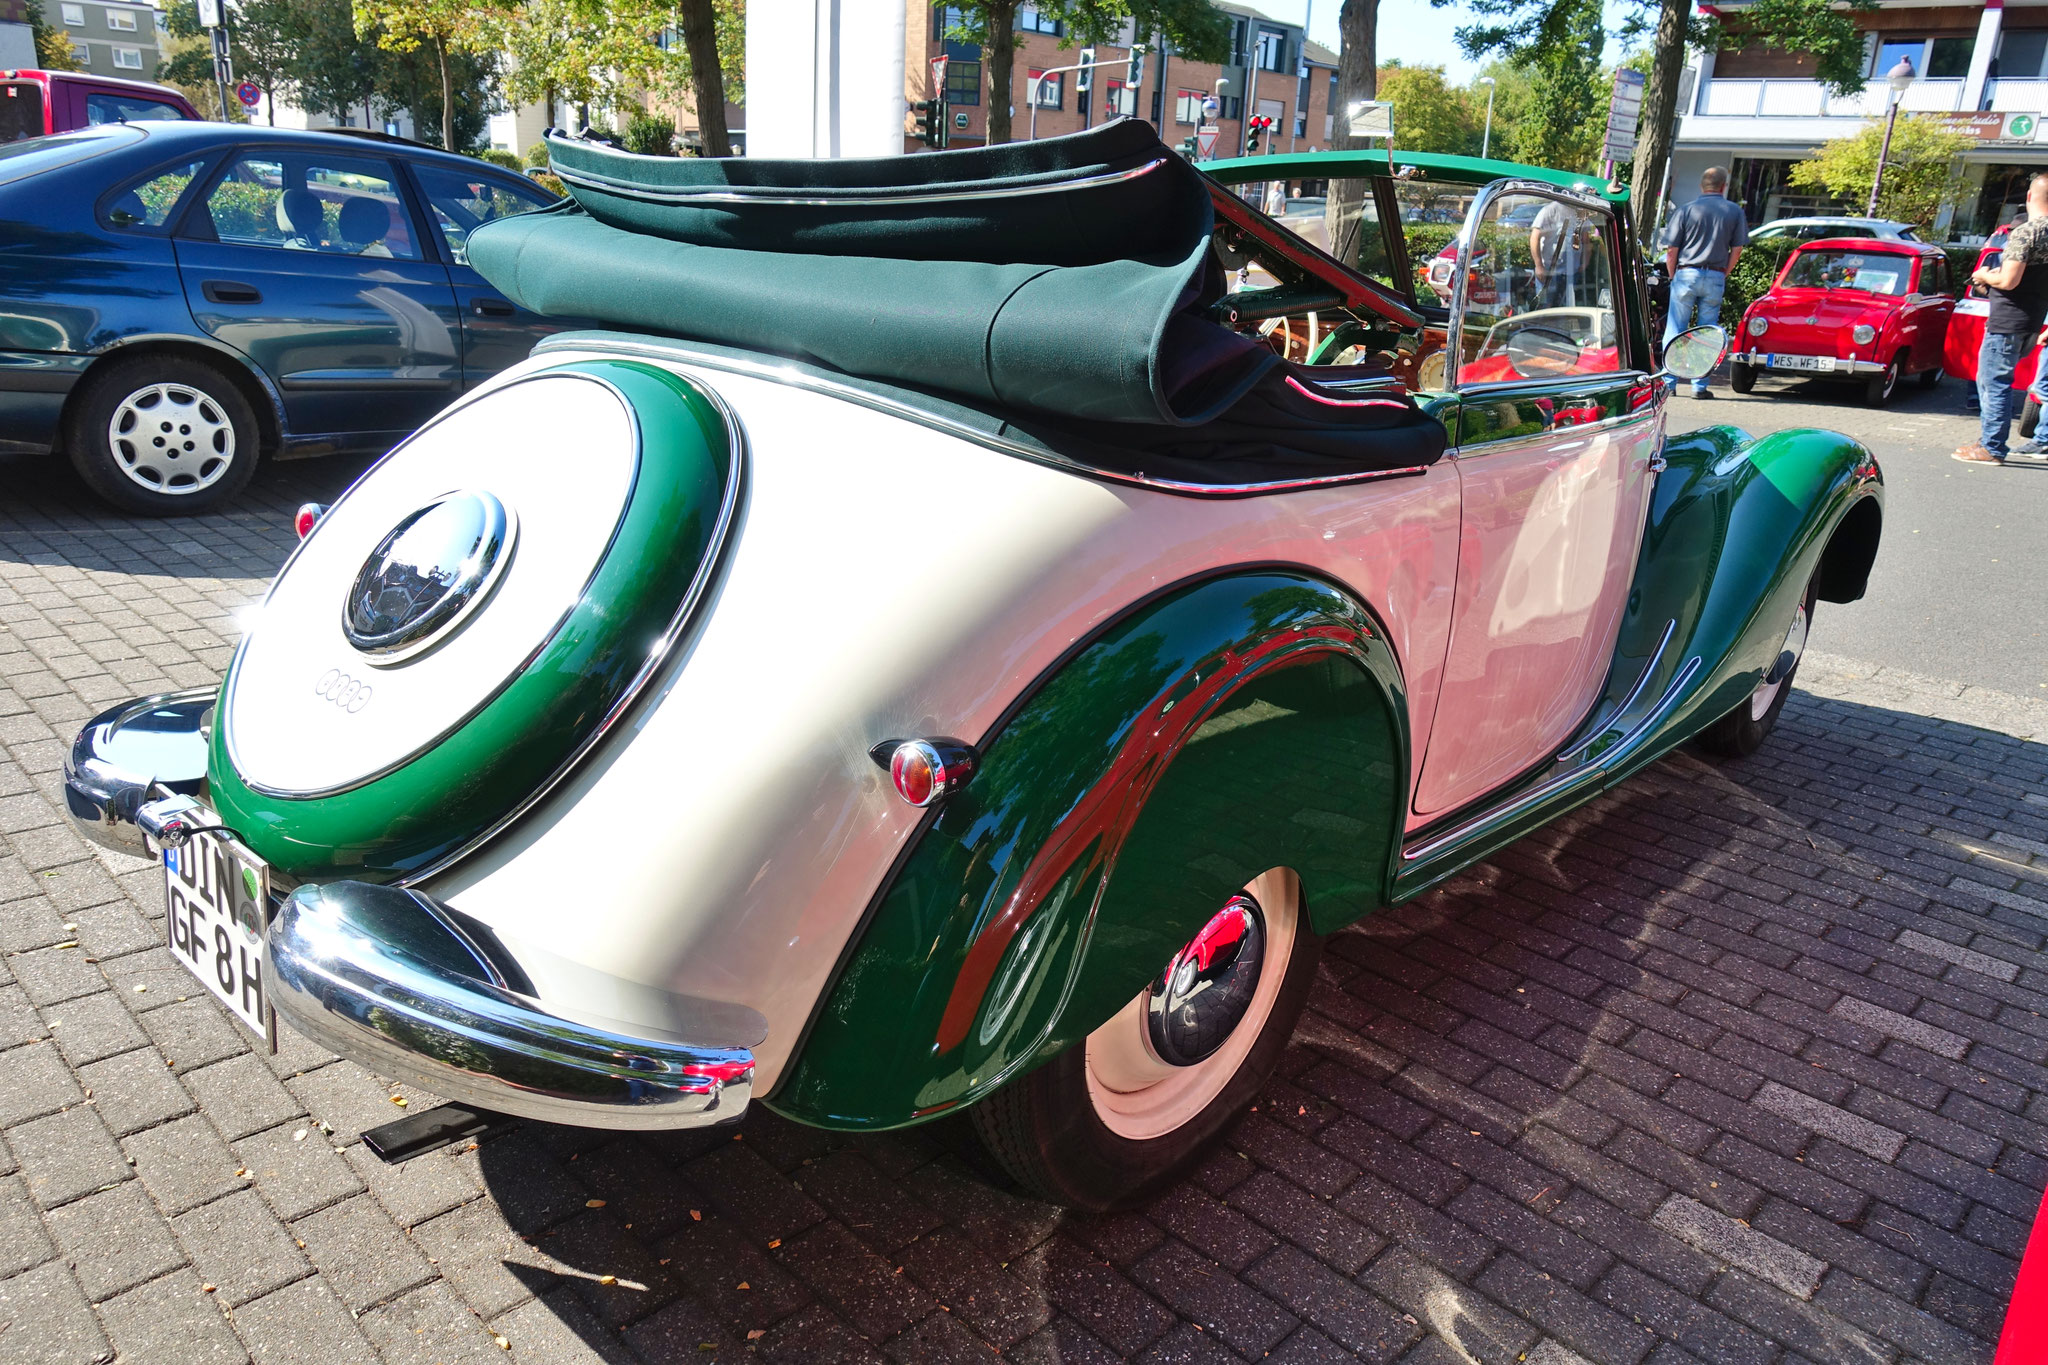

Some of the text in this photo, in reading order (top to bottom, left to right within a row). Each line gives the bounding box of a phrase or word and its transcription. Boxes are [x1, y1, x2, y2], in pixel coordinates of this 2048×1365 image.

[1921, 113, 2001, 126] Blmentudio
[1774, 355, 1793, 367] WES
[180, 833, 237, 927] DIN
